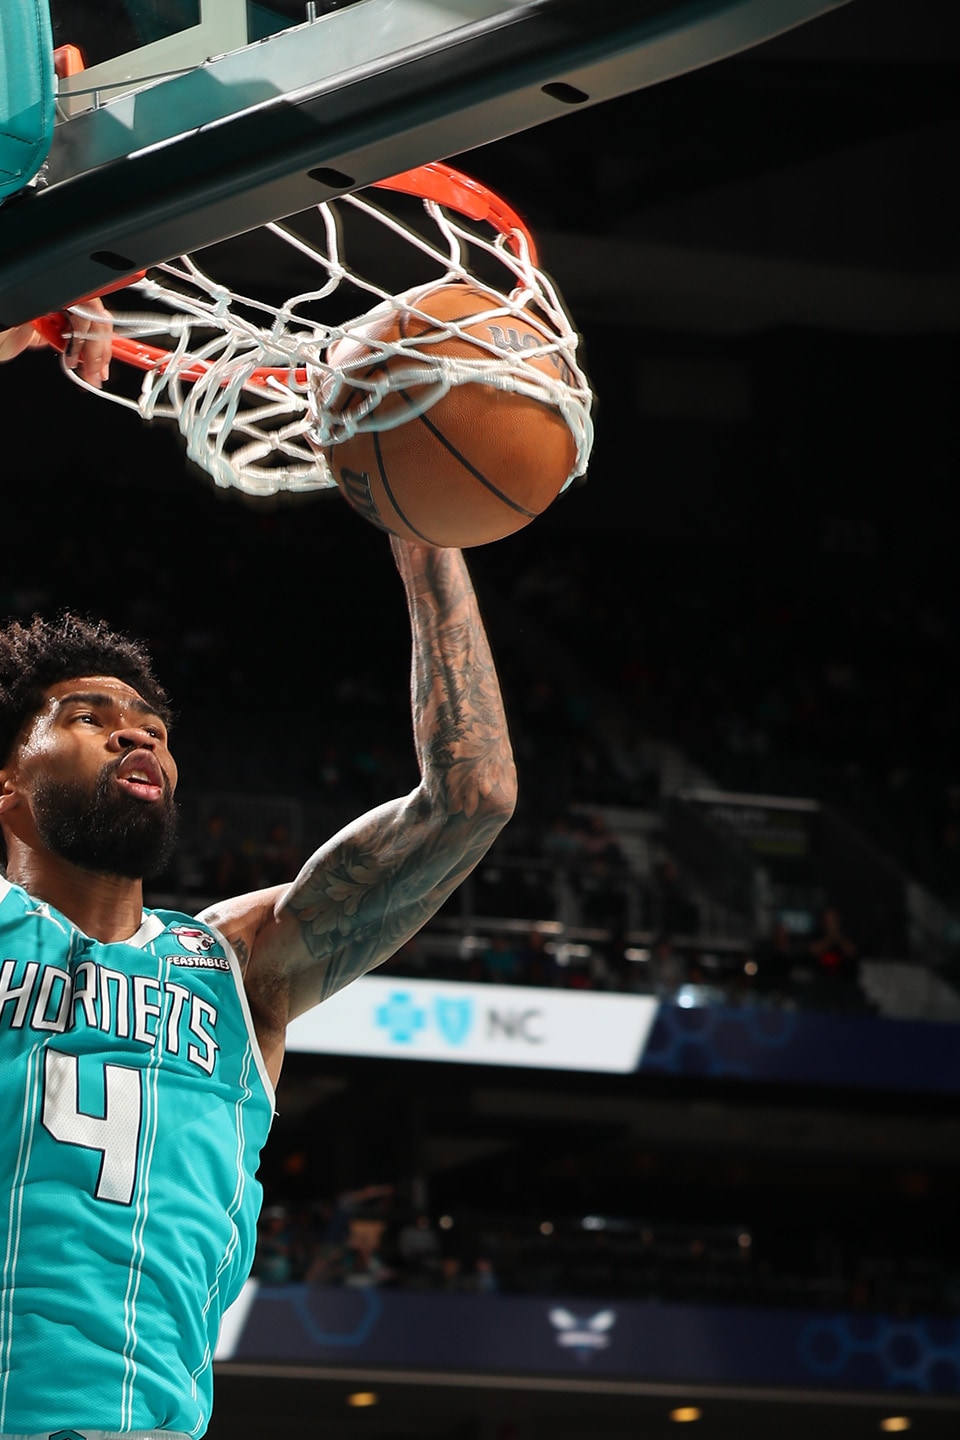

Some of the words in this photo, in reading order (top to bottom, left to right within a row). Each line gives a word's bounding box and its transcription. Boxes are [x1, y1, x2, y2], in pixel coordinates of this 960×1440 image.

[166, 955, 231, 970] FEASTABLES
[487, 1007, 547, 1044] NC
[41, 1045, 142, 1207] 4
